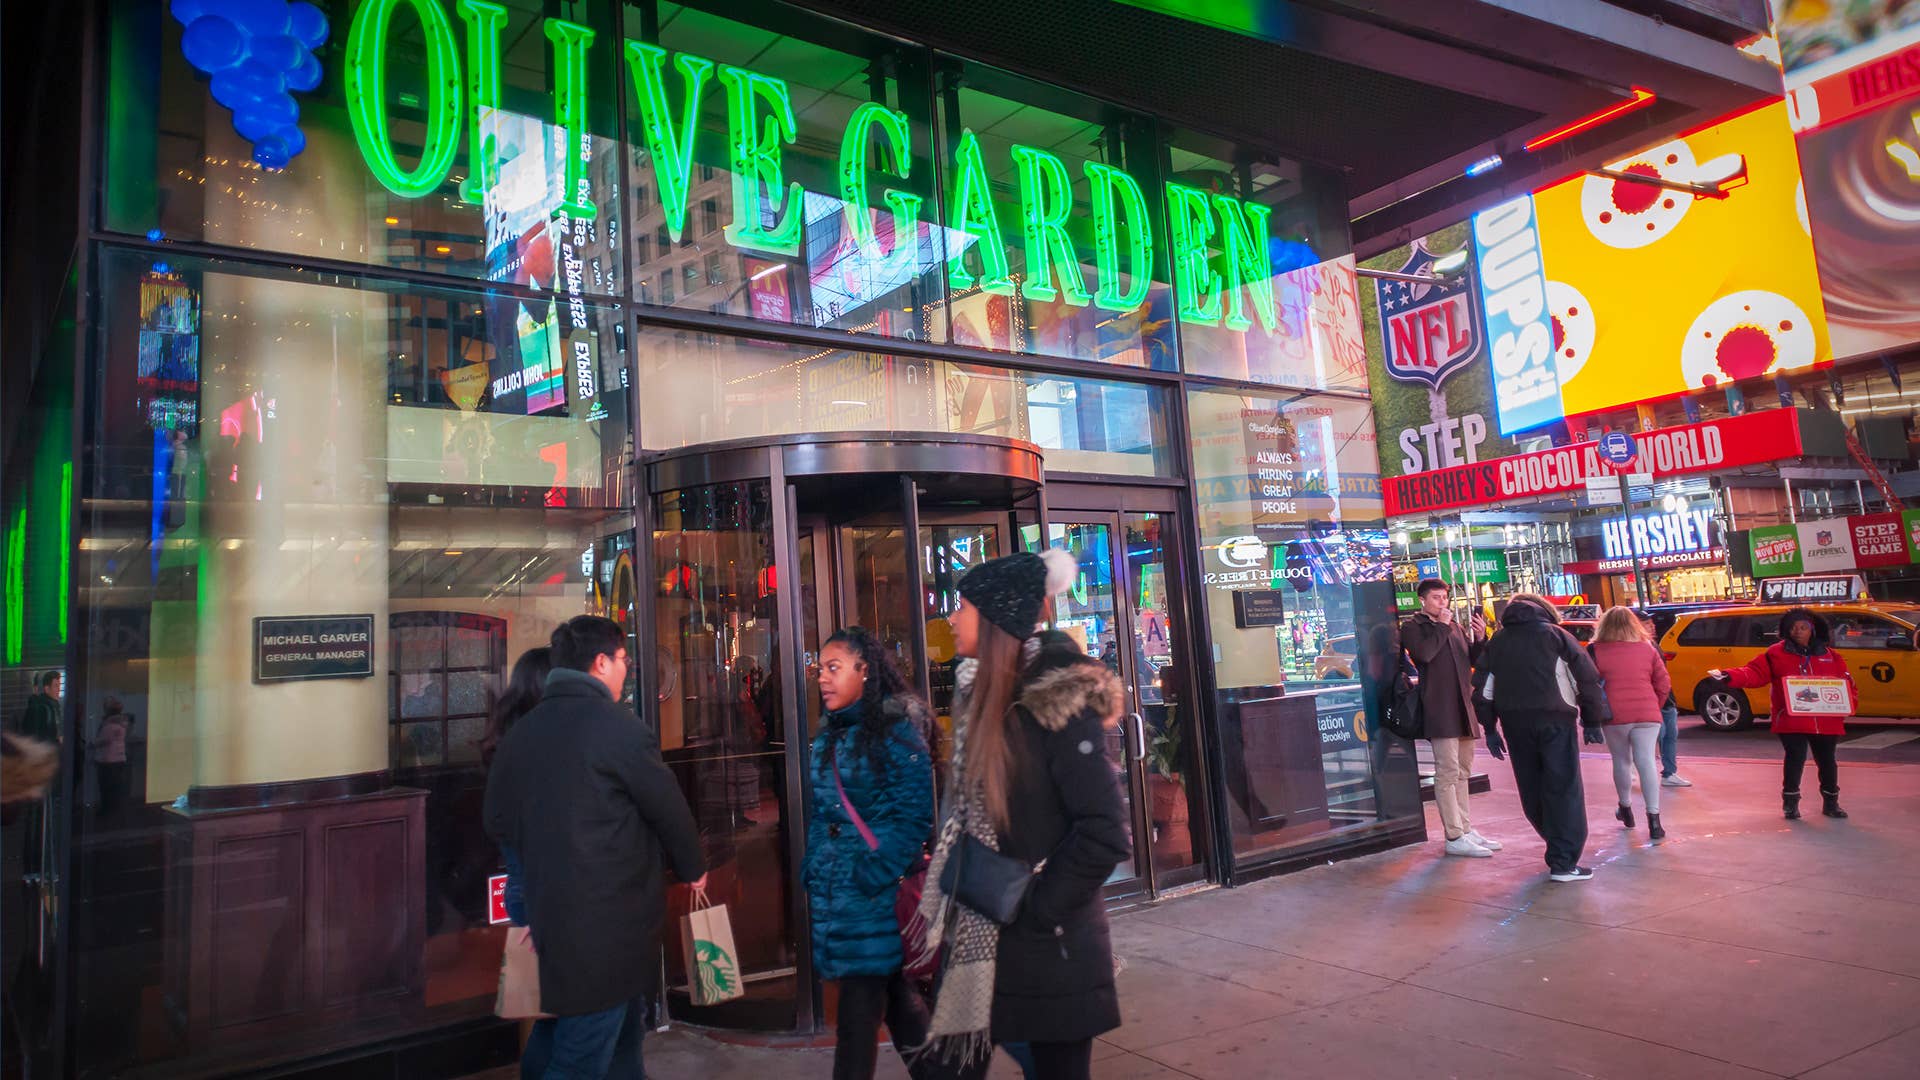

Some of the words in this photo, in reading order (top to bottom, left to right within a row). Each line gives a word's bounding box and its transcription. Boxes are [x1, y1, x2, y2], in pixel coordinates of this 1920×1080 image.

[344, 0, 803, 257] OLIVE
[840, 102, 1278, 336] GARDEN
[1390, 300, 1470, 368] NFL
[1399, 413, 1487, 475] STEP
[1256, 451, 1293, 464] ALWAYS
[1258, 467, 1293, 480] HIRING
[1397, 465, 1497, 510] HERSHEY'S
[1500, 445, 1618, 495] CHOCOLA
[1635, 425, 1724, 474] WORLD
[1263, 484, 1292, 497] GREAT
[1262, 501, 1297, 514] PEOPLE
[1602, 508, 1715, 558] HERSHEY'
[1855, 523, 1898, 538] STEP
[1857, 536, 1880, 545] INTO
[1881, 534, 1901, 543] THE
[1755, 545, 1773, 559] NOW
[1774, 539, 1797, 554] OPEN!
[1808, 547, 1848, 558] EXPERIENCE
[1859, 543, 1903, 556] GAME
[1599, 556, 1648, 570] HERSHE'S
[1652, 551, 1711, 566] CHOCOLATE
[1782, 581, 1847, 598] BLOCKERS
[1147, 617, 1163, 642] A
[263, 633, 317, 646] MICHAEL
[320, 632, 368, 643] GARVER
[266, 652, 315, 662] GENERAL
[316, 650, 366, 660] MANAGER
[1322, 730, 1351, 743] Brooklyn
